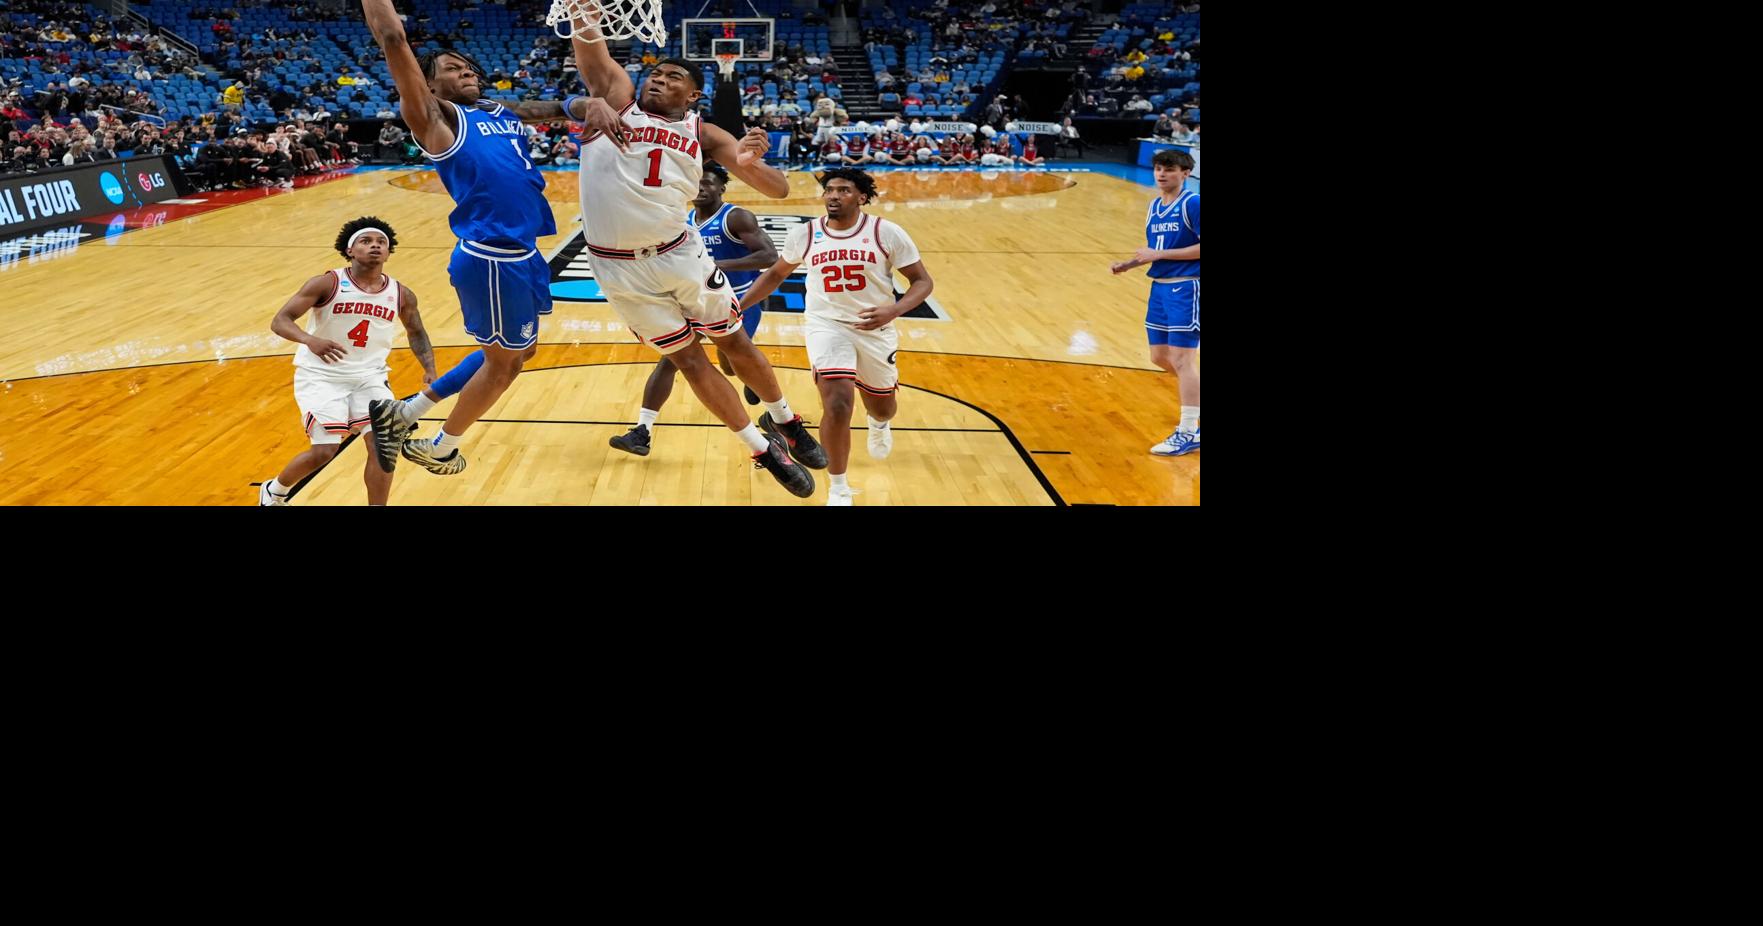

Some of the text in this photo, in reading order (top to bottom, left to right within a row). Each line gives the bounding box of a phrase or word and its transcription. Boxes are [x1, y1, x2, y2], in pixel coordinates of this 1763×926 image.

[476, 119, 527, 136] BILLIKEN
[934, 123, 964, 132] NOISE
[1018, 123, 1049, 132] NOISE
[510, 138, 532, 170] 1
[643, 148, 663, 187] 1
[149, 172, 165, 188] LG
[20, 179, 81, 221] FOUR
[1155, 234, 1165, 251] 11
[811, 249, 877, 267] GEORGIA
[821, 264, 867, 293] 25
[332, 302, 396, 322] GEORGIA
[347, 319, 370, 348] 4
